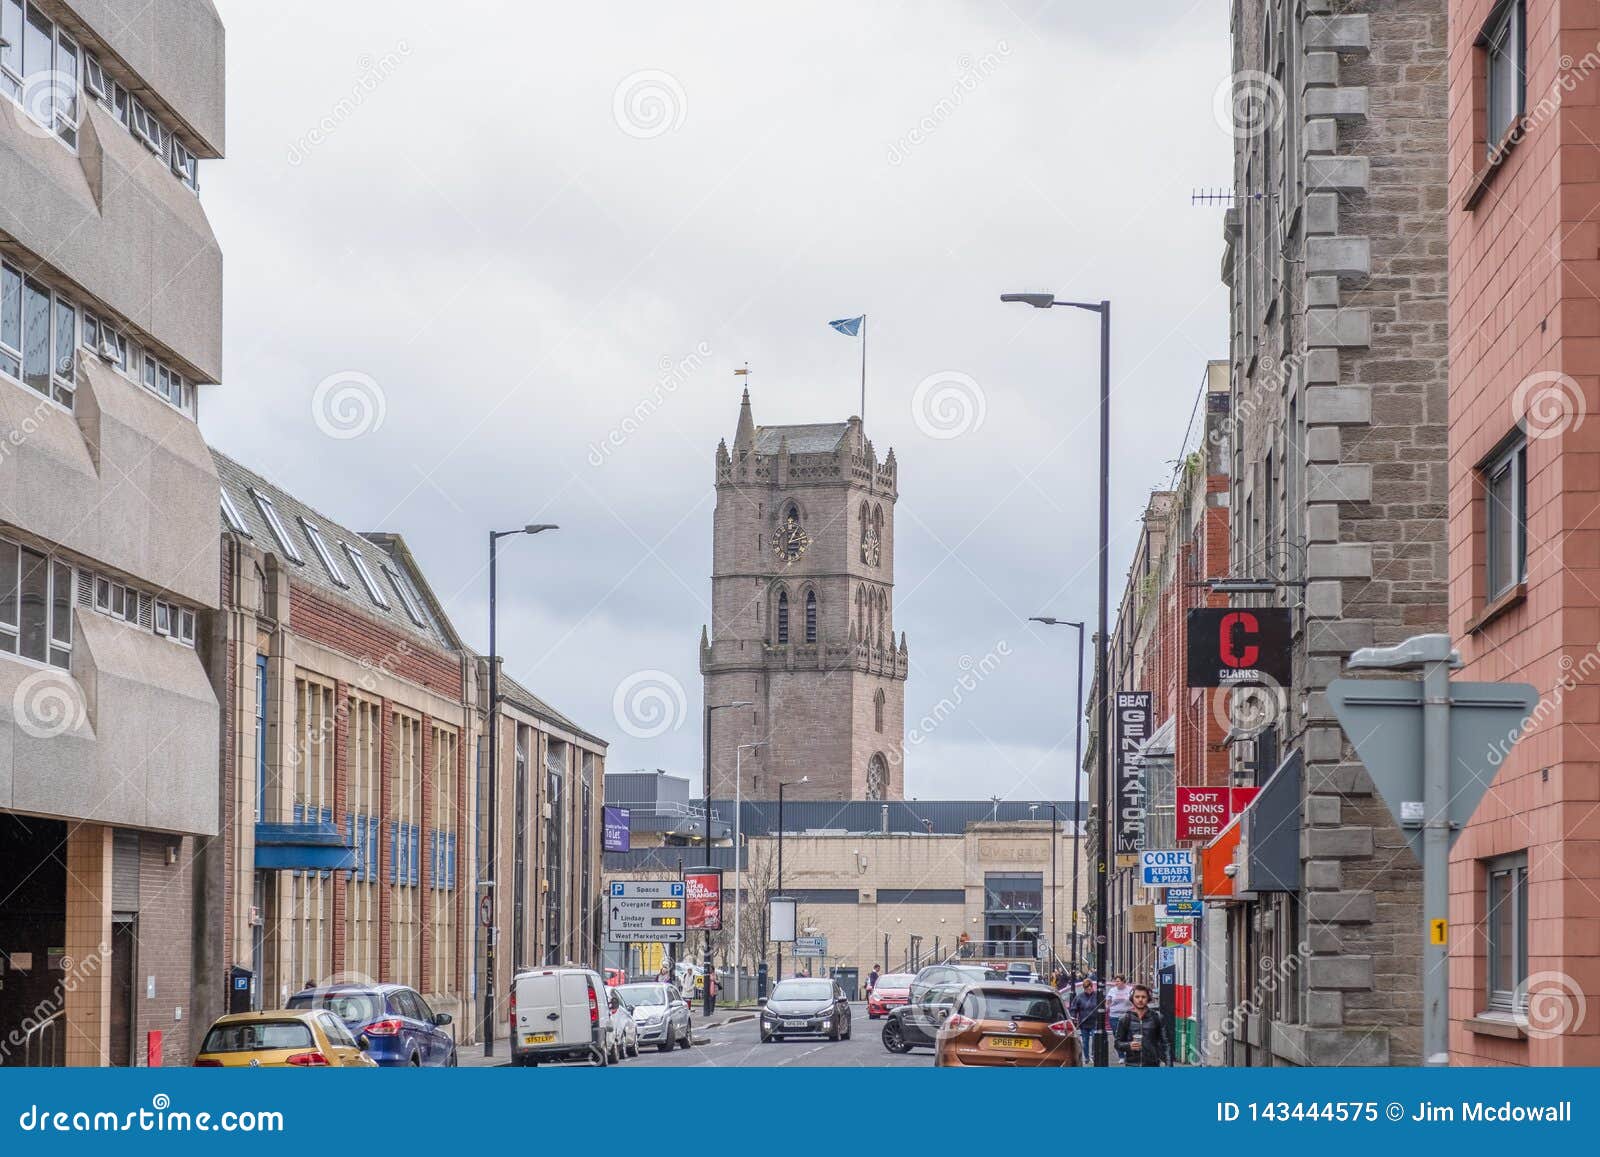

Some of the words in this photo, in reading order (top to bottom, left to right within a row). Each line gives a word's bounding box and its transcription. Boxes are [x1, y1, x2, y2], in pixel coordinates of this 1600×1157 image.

[1219, 612, 1259, 668] C
[1219, 669, 1259, 679] CLARKS
[1119, 695, 1148, 707] BEAT
[1189, 793, 1218, 802] SOFT
[1183, 804, 1224, 813] DRINKS
[1188, 815, 1218, 824] SOLD
[612, 829, 621, 839] Let
[1188, 826, 1218, 835] HERE
[1118, 833, 1145, 851] live
[1098, 863, 1105, 873] 2
[1152, 867, 1189, 875] KEBABS
[1436, 922, 1444, 941] 1
